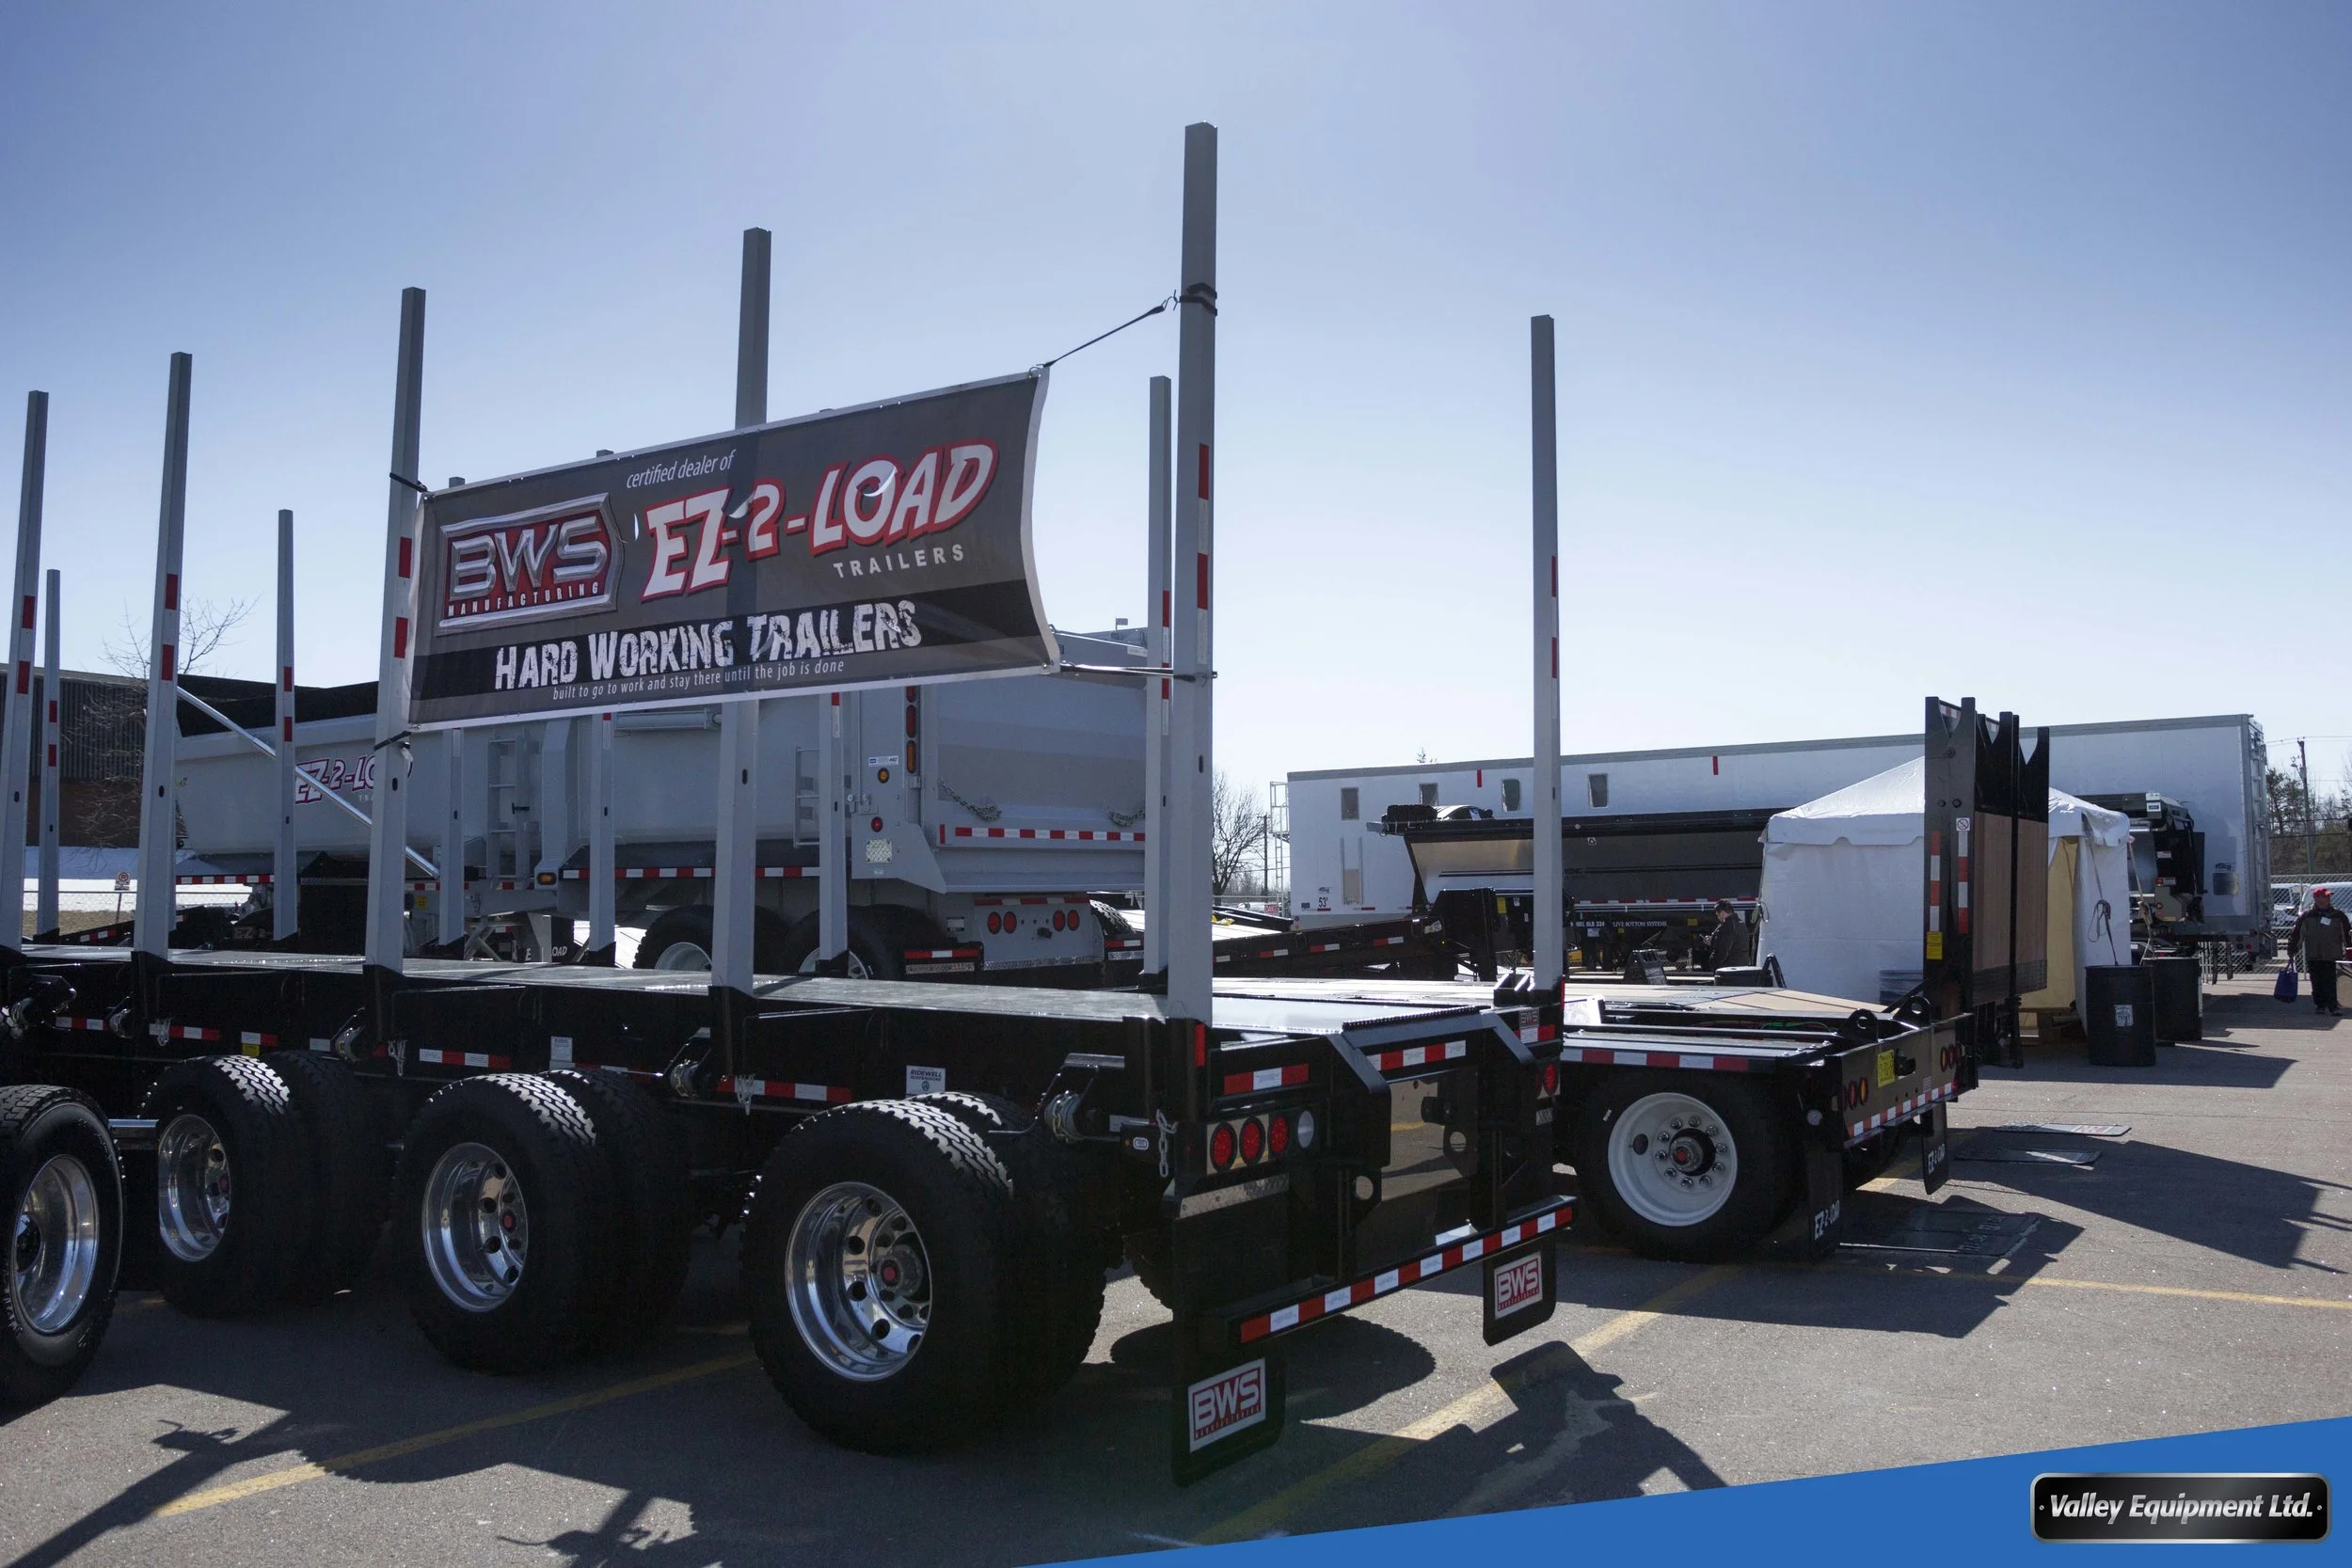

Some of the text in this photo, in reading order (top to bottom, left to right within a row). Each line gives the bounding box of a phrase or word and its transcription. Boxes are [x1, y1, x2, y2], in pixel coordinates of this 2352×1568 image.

[627, 449, 737, 489] certified dealer of
[641, 438, 999, 603] EZ-2-LOAD
[450, 515, 608, 601] BWS
[833, 543, 964, 578] TRAILERS
[448, 581, 598, 617] MANUFACTURING
[495, 600, 922, 690] HARD WORKING TRAILERS
[553, 659, 845, 701] built to go to work and stay there until the job is done
[1498, 1259, 1539, 1305] BWS
[1194, 1370, 1260, 1431] BWS
